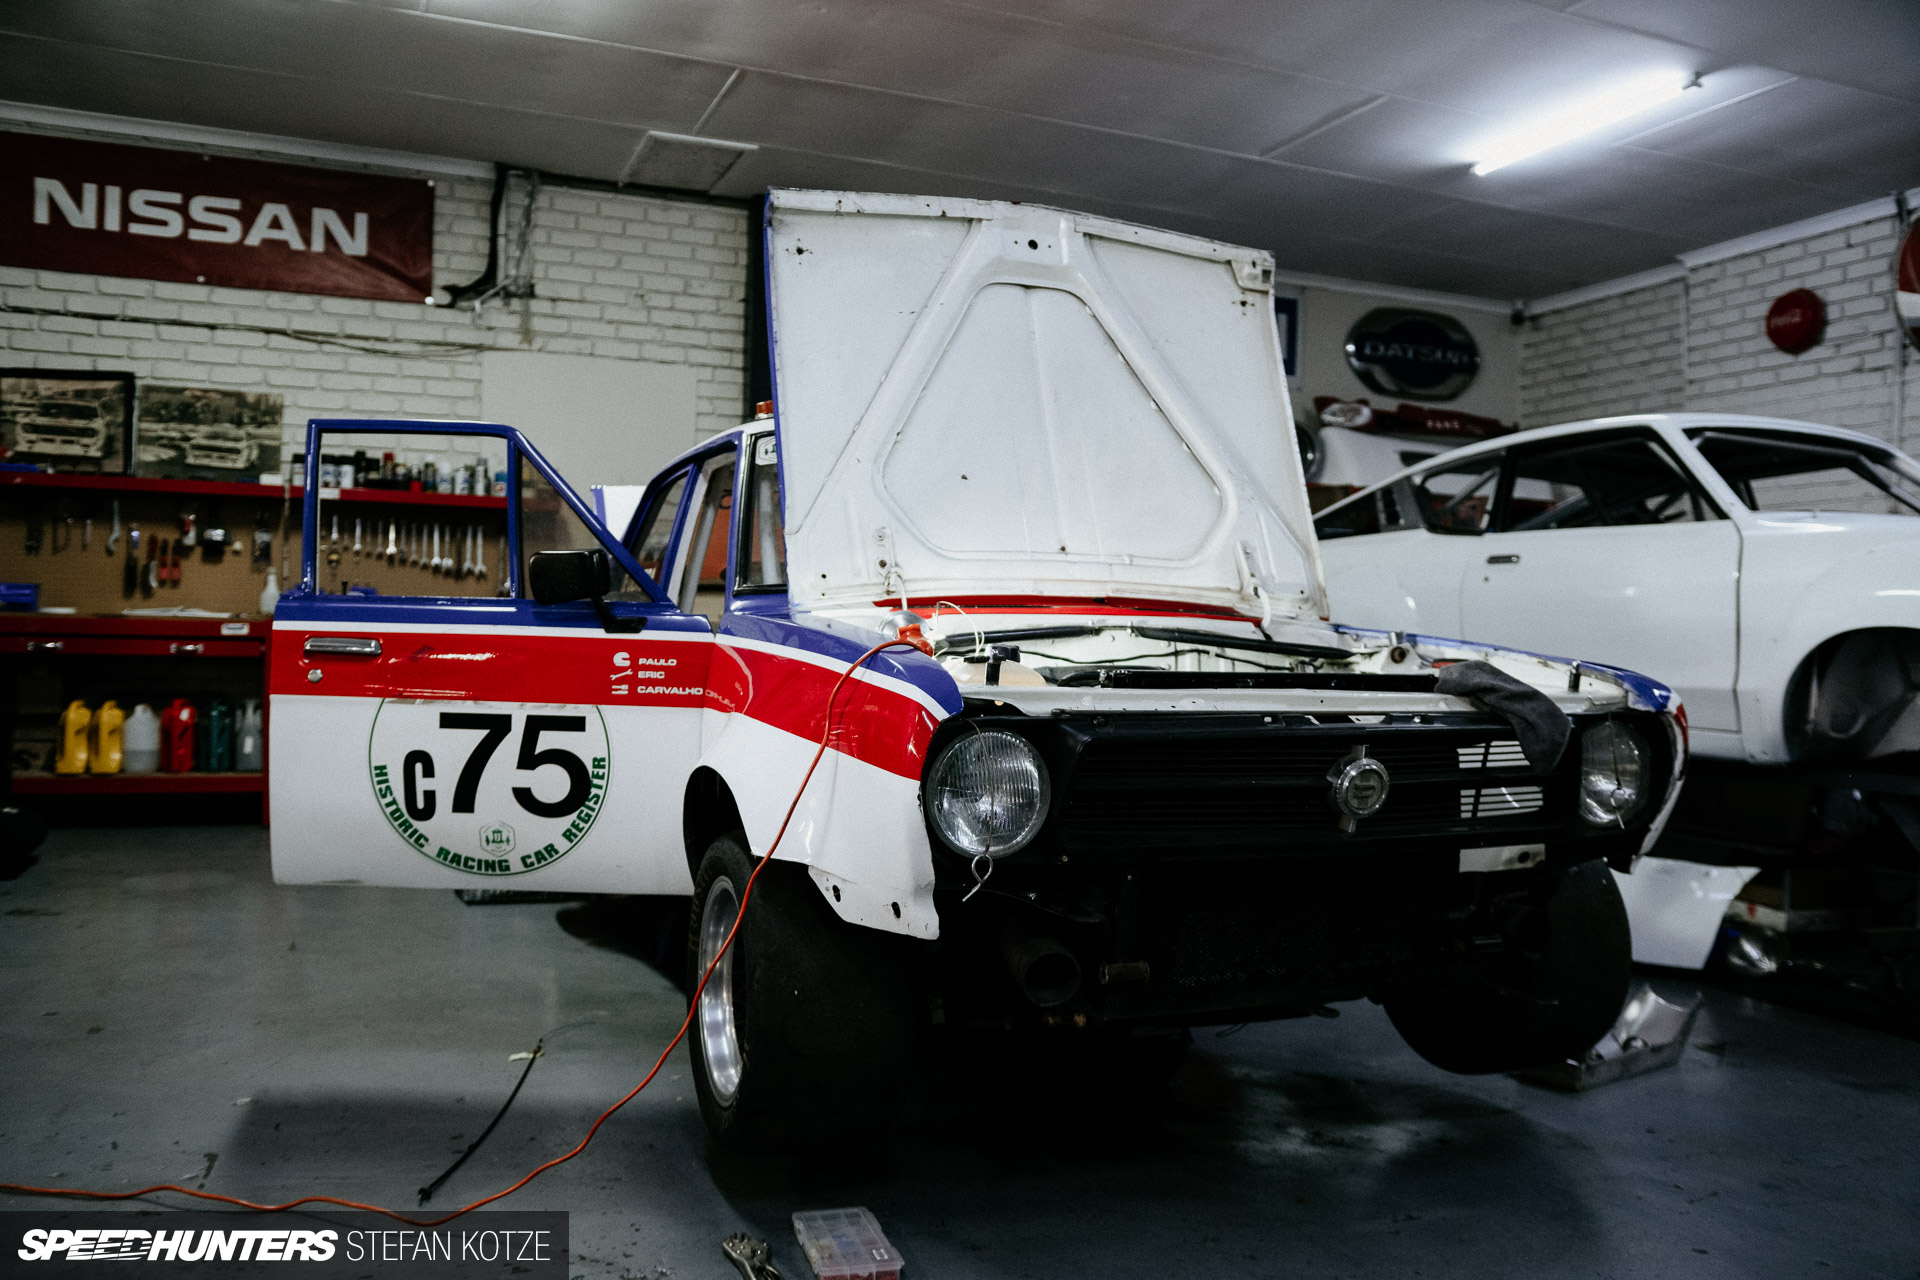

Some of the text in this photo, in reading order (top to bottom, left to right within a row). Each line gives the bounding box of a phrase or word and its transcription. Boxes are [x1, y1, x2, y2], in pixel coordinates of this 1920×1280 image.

[34, 177, 368, 257] NISSAN
[638, 657, 677, 666] PAULO
[637, 670, 665, 679] ERIC
[637, 686, 703, 695] CARVALHO
[373, 764, 430, 849] HISTORIC
[435, 846, 511, 873] RACING
[520, 843, 560, 869] CAR
[561, 756, 606, 844] REGISTER
